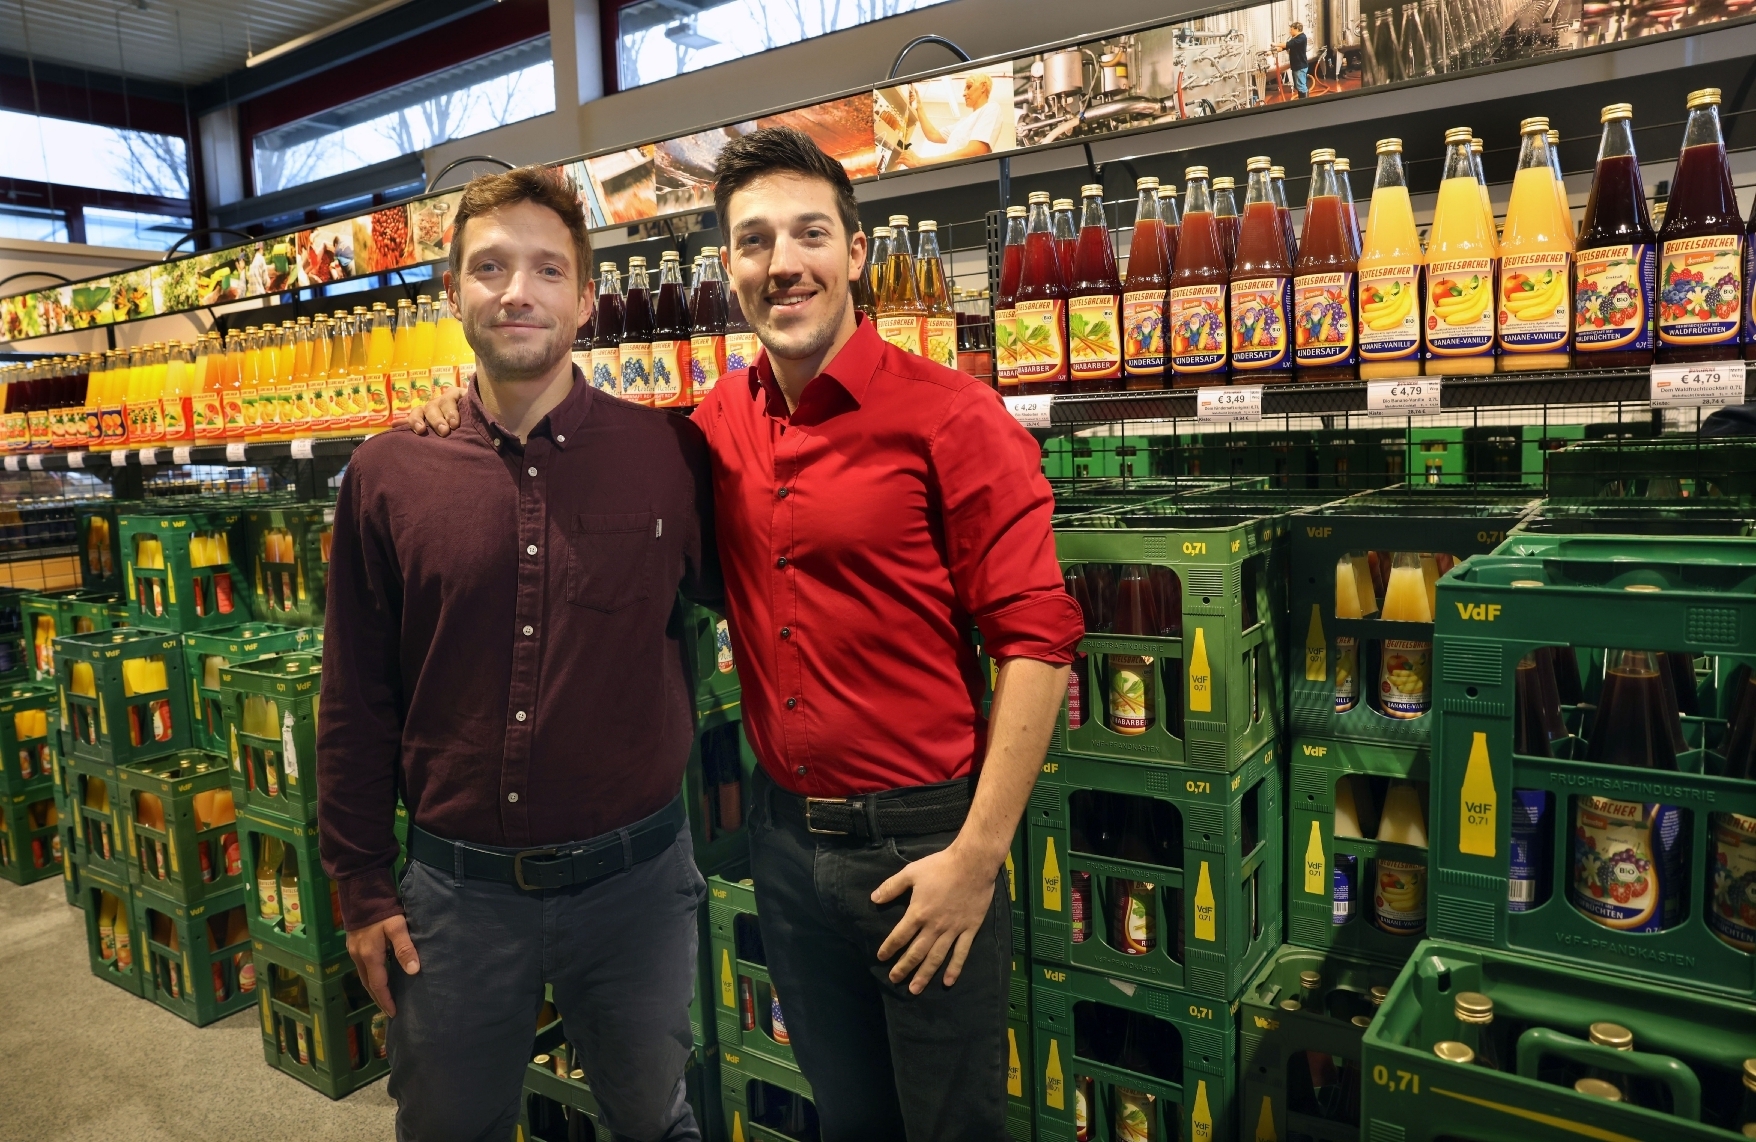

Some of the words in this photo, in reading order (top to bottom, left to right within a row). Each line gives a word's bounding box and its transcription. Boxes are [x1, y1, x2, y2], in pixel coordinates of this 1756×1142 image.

[1665, 237, 1735, 254] BEUTELSBACHER
[1504, 253, 1564, 268] BEUTELSBACHER
[1431, 259, 1488, 274] BEUTELSBACHER
[1360, 266, 1411, 281] BEUTELSBACHER
[1669, 326, 1726, 335] WALDFRÜCHTEN
[1433, 336, 1488, 346] BANANE-VANILLE
[1504, 332, 1562, 342] BANANE-VANILLE
[1361, 341, 1411, 351] BANANE-VANILLE
[1175, 355, 1218, 365] KINDERSAFT
[1681, 374, 1689, 385] €
[1693, 373, 1721, 386] 4,79
[1391, 387, 1398, 396] €
[1400, 386, 1422, 397] 4,79
[1218, 395, 1224, 404] €
[1226, 395, 1245, 405] 3,49
[1014, 403, 1020, 411] €
[1020, 403, 1037, 412] 4,29
[172, 520, 187, 528] VdF
[1306, 527, 1332, 538] VdF
[1477, 531, 1504, 544] 0,7l
[1182, 541, 1206, 556] 0,7l
[1230, 539, 1241, 554] VdF
[1455, 602, 1502, 621] VdF
[162, 640, 177, 649] 0,7l
[243, 643, 258, 652] VdF
[1083, 641, 1164, 652] FRUCHTSAFTINDUSTRIE
[105, 649, 121, 658] VdF
[1308, 647, 1325, 655] VdF
[1191, 675, 1208, 684] VdF
[296, 681, 312, 691] VdF
[1303, 745, 1328, 757] VdF
[1041, 762, 1059, 774] dF
[178, 783, 193, 792] VdF
[1186, 781, 1210, 794] 0,7l
[1231, 775, 1241, 792] VdF
[1550, 772, 1717, 802] FRUCHTSAFTINDUSTRIE
[1465, 801, 1492, 815] VdF
[1467, 815, 1488, 826] 0,7l
[1086, 861, 1166, 881] FRUCHTSAFTINDUSTRIE
[1307, 861, 1323, 870] VdF
[1308, 869, 1321, 877] 0,7l
[1619, 867, 1635, 876] BIO
[1044, 877, 1059, 885] VdF
[712, 888, 728, 900] VdF
[189, 905, 206, 917] VdF
[1196, 905, 1213, 913] VdF
[1556, 932, 1696, 967] VdF-PFANDKASTEN
[325, 963, 340, 975] VdF
[1043, 968, 1066, 982] VdF
[1189, 1005, 1213, 1020] 0,7l
[725, 1052, 740, 1064] VdF
[1372, 1064, 1420, 1094] 0,7l
[1194, 1121, 1210, 1130] VdF
